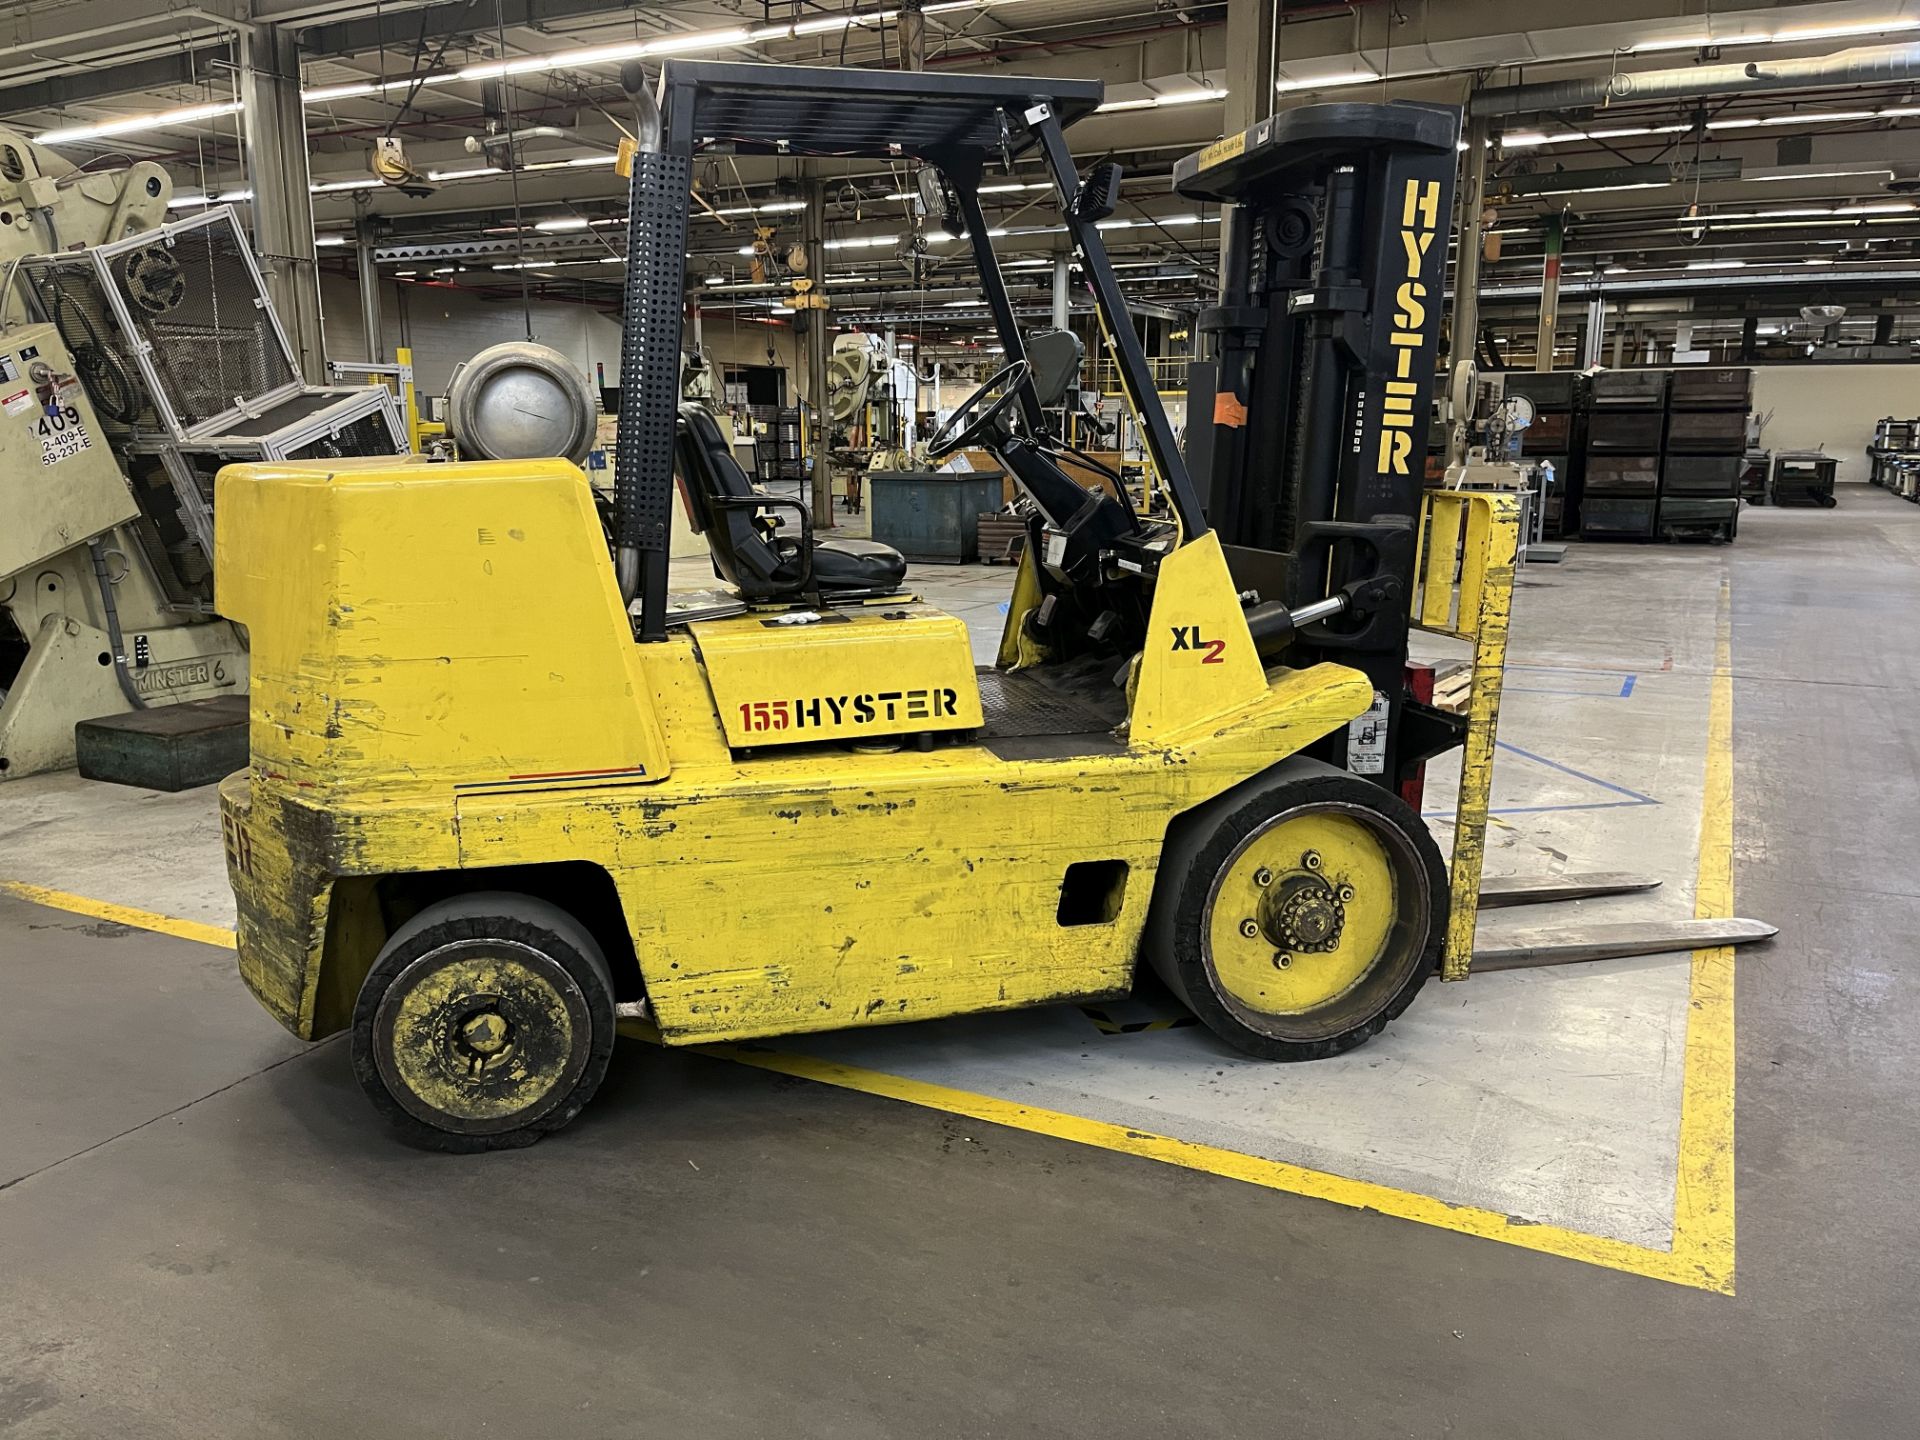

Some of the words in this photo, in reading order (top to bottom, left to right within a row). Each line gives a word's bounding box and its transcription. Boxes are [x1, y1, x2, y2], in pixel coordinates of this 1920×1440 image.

[1377, 179, 1440, 474] HYSTER
[42, 437, 92, 466] 59-237-E
[43, 426, 87, 452] 2-409-E
[139, 664, 208, 692] MINSTER
[214, 660, 225, 681] 6
[740, 701, 789, 732] 155
[796, 688, 957, 728] HYSTER
